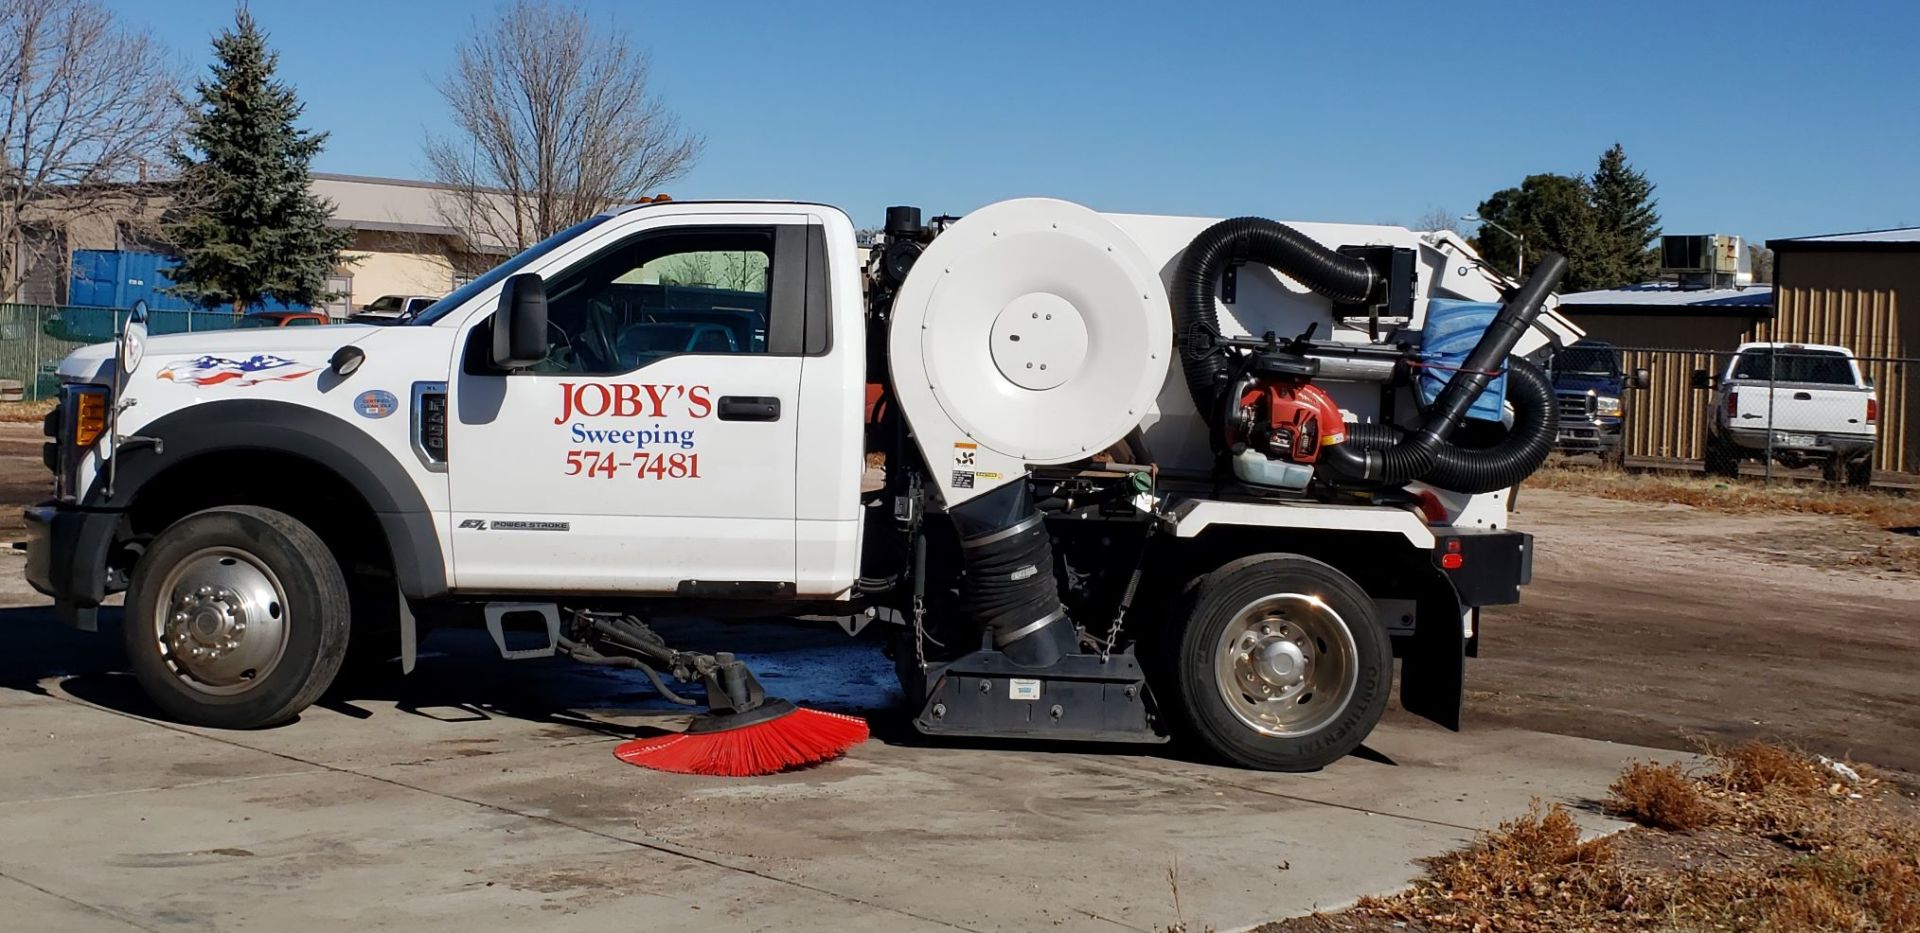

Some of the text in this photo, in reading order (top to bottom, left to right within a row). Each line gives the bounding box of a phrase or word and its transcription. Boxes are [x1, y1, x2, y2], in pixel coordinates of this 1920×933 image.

[554, 383, 712, 425] JOBY'S
[572, 423, 694, 449] Sweeping
[564, 450, 701, 480] 574-7481
[493, 520, 567, 529] POWER STROKE
